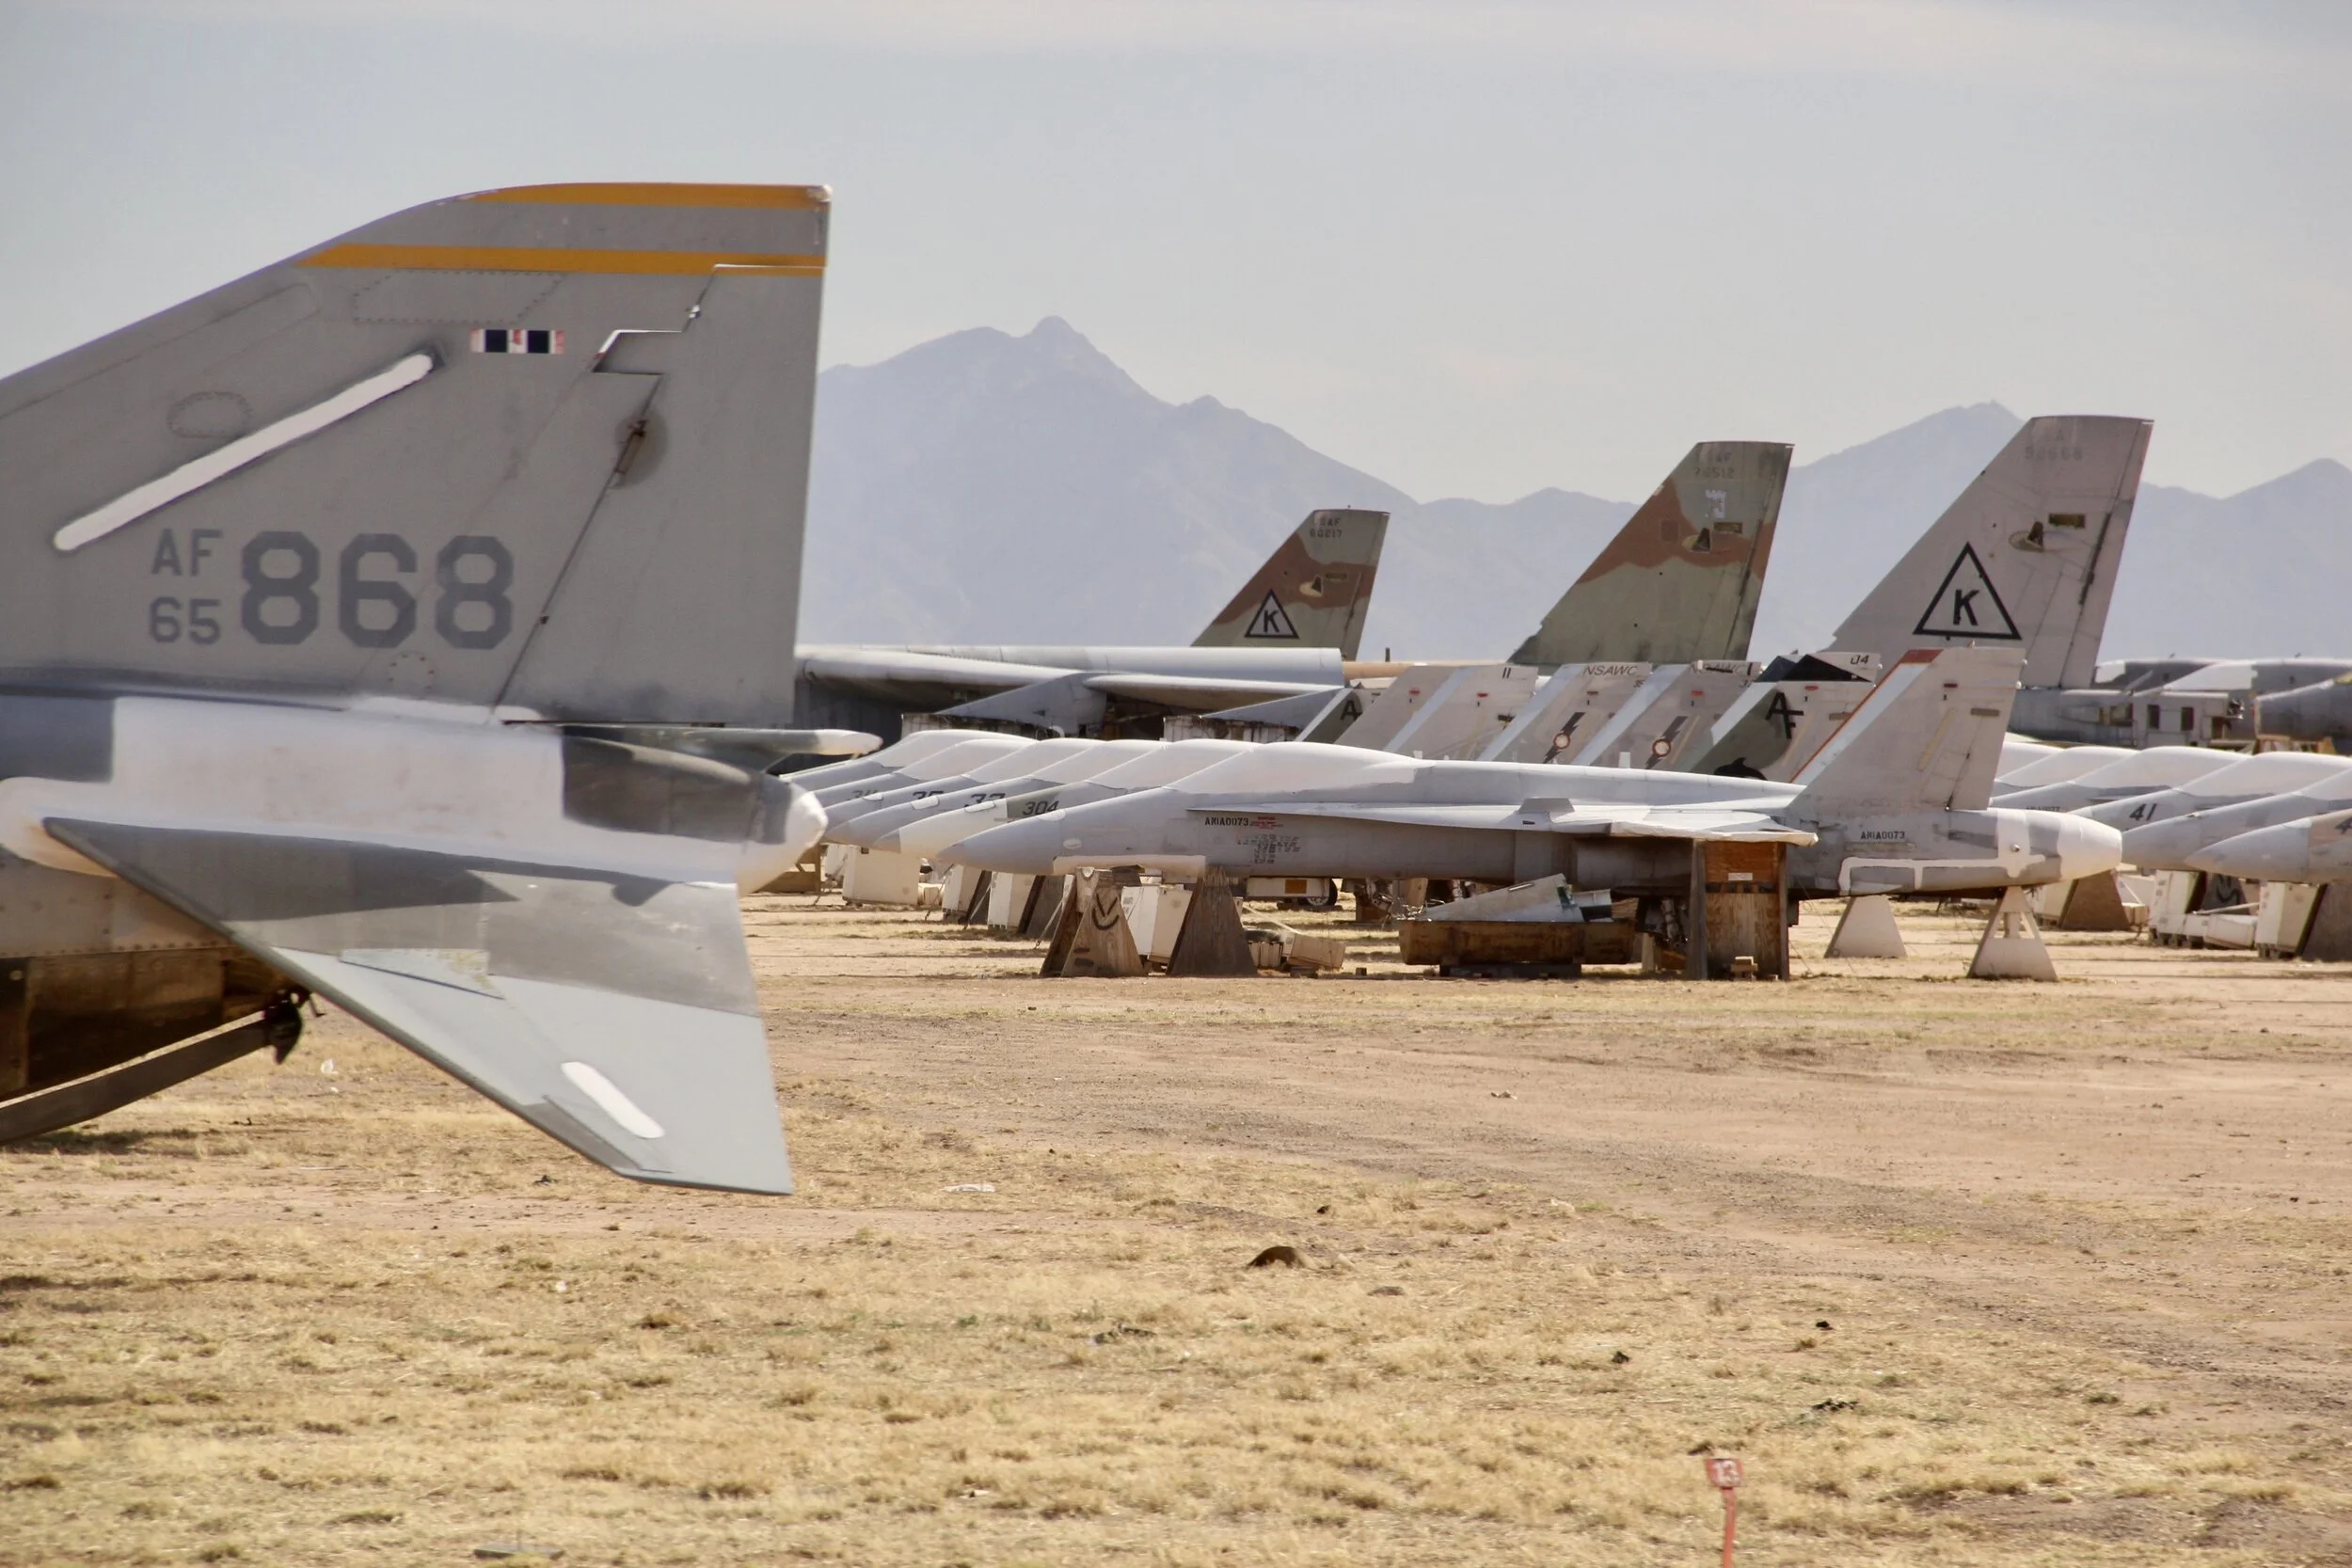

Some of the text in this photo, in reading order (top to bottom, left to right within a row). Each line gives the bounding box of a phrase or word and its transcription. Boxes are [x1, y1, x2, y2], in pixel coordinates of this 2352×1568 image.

[151, 529, 223, 577] AF
[241, 531, 515, 650] 868
[149, 596, 222, 644] 65
[1263, 610, 1280, 633] K
[1952, 589, 1980, 626] K
[1582, 664, 1639, 676] NSAWC
[1022, 800, 1059, 816] 304
[2128, 803, 2158, 821] 41
